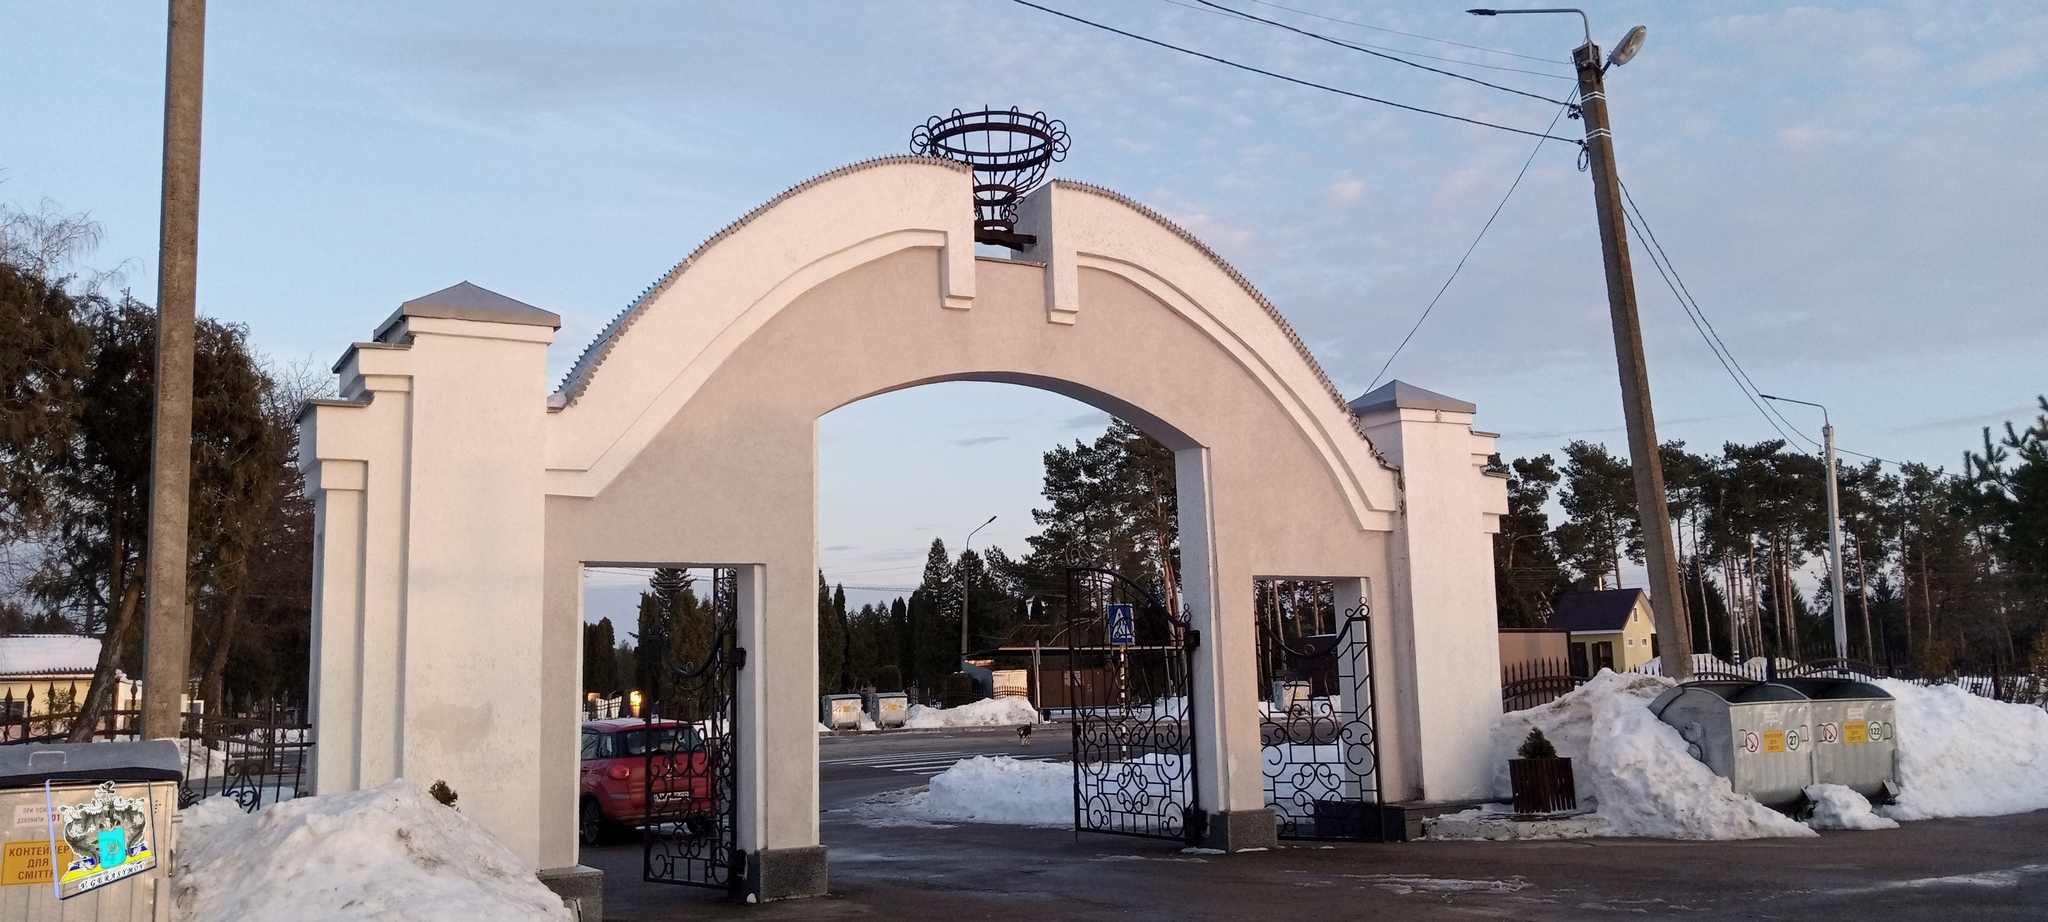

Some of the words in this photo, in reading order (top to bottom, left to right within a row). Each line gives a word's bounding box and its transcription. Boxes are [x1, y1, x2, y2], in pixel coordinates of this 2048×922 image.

[1870, 727, 1880, 735] 122
[1789, 736, 1796, 745] 27
[48, 814, 60, 822] 01
[27, 858, 49, 868] ДЛЯ
